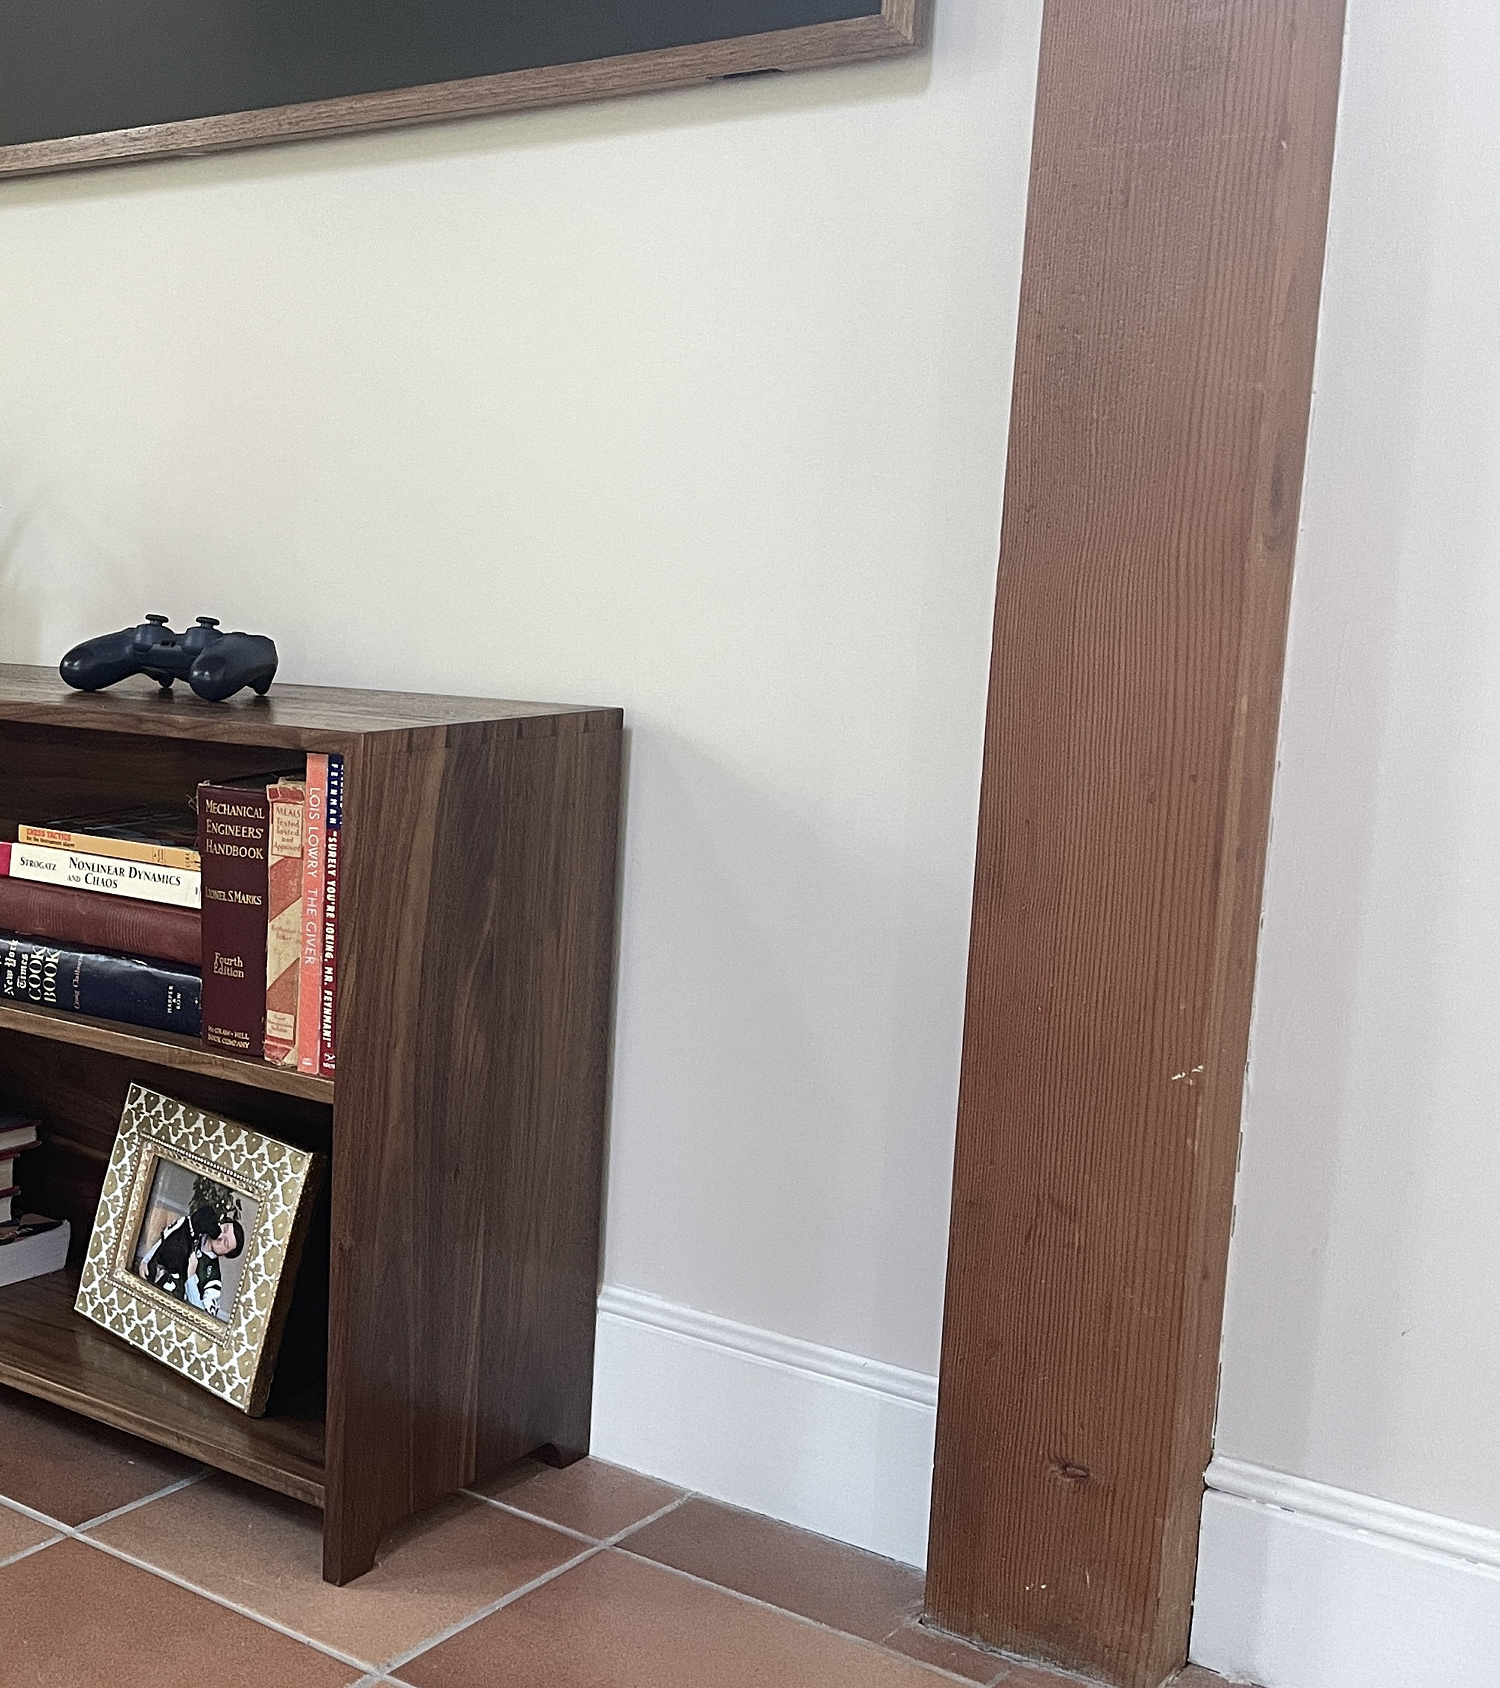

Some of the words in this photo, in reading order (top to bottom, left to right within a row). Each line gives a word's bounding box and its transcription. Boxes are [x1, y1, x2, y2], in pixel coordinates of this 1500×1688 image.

[308, 787, 321, 820] LOIS
[328, 763, 339, 825] FEYNMAN
[205, 799, 266, 820] MECHANICAL
[206, 819, 264, 839] ENGINEERS'
[20, 856, 57, 871] STROGATZ
[206, 839, 264, 860] HANDBOOK
[306, 827, 320, 878] LOWRY
[67, 874, 81, 882] AND
[84, 872, 118, 888] CHAOS
[69, 856, 125, 877] NONLINEAR
[128, 866, 181, 886] DYNAMICS
[205, 886, 228, 901] LIONEL
[234, 890, 262, 905] MARKS
[306, 888, 318, 917] THE
[325, 880, 337, 919] YOU'RE
[4, 939, 19, 968] York
[304, 922, 317, 965] GIVER
[323, 922, 336, 962] JOKING,
[16, 953, 29, 989] Times
[27, 946, 48, 1001] COOK
[213, 963, 245, 979] Edition
[214, 952, 244, 968] Fourth
[3, 969, 15, 996] New
[42, 947, 62, 1003] BOOK
[323, 966, 334, 986] MR.
[221, 1037, 250, 1049] COMPANY
